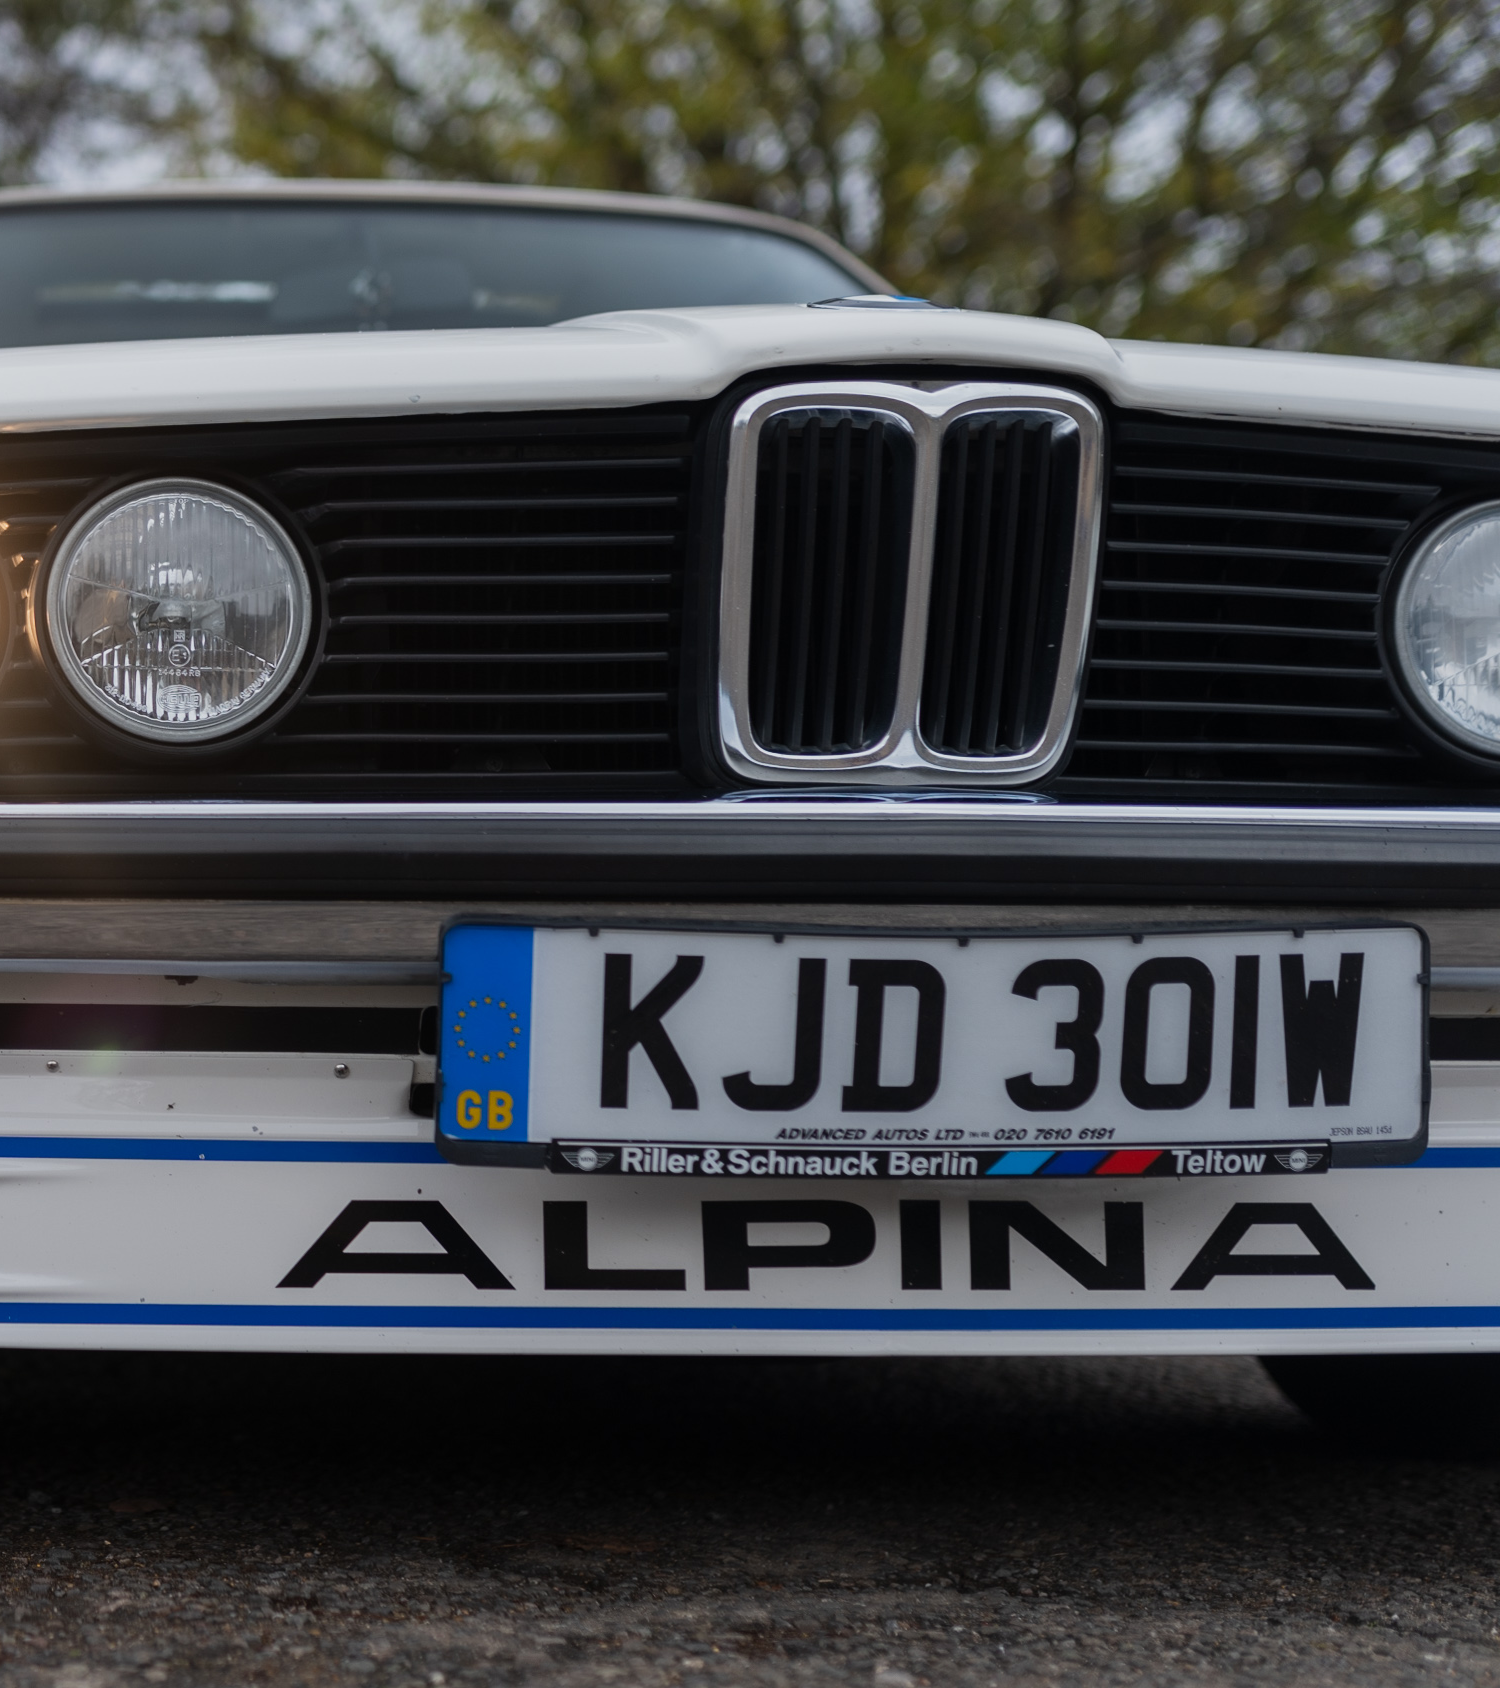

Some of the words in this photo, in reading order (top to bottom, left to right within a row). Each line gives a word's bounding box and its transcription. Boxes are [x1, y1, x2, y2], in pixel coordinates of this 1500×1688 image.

[600, 953, 948, 1113] KJD
[1004, 951, 1365, 1113] 301W
[456, 1090, 514, 1131] GB
[775, 1127, 867, 1141] ADVANCED
[871, 1128, 930, 1142] AUTOS
[933, 1128, 965, 1141] LTD
[993, 1128, 1029, 1141] 020
[1033, 1128, 1073, 1141] 7610
[1077, 1127, 1116, 1140] 6191
[887, 1152, 978, 1177] Berlin
[1171, 1149, 1267, 1175] Teltow
[275, 1199, 1377, 1291] ALPINA
